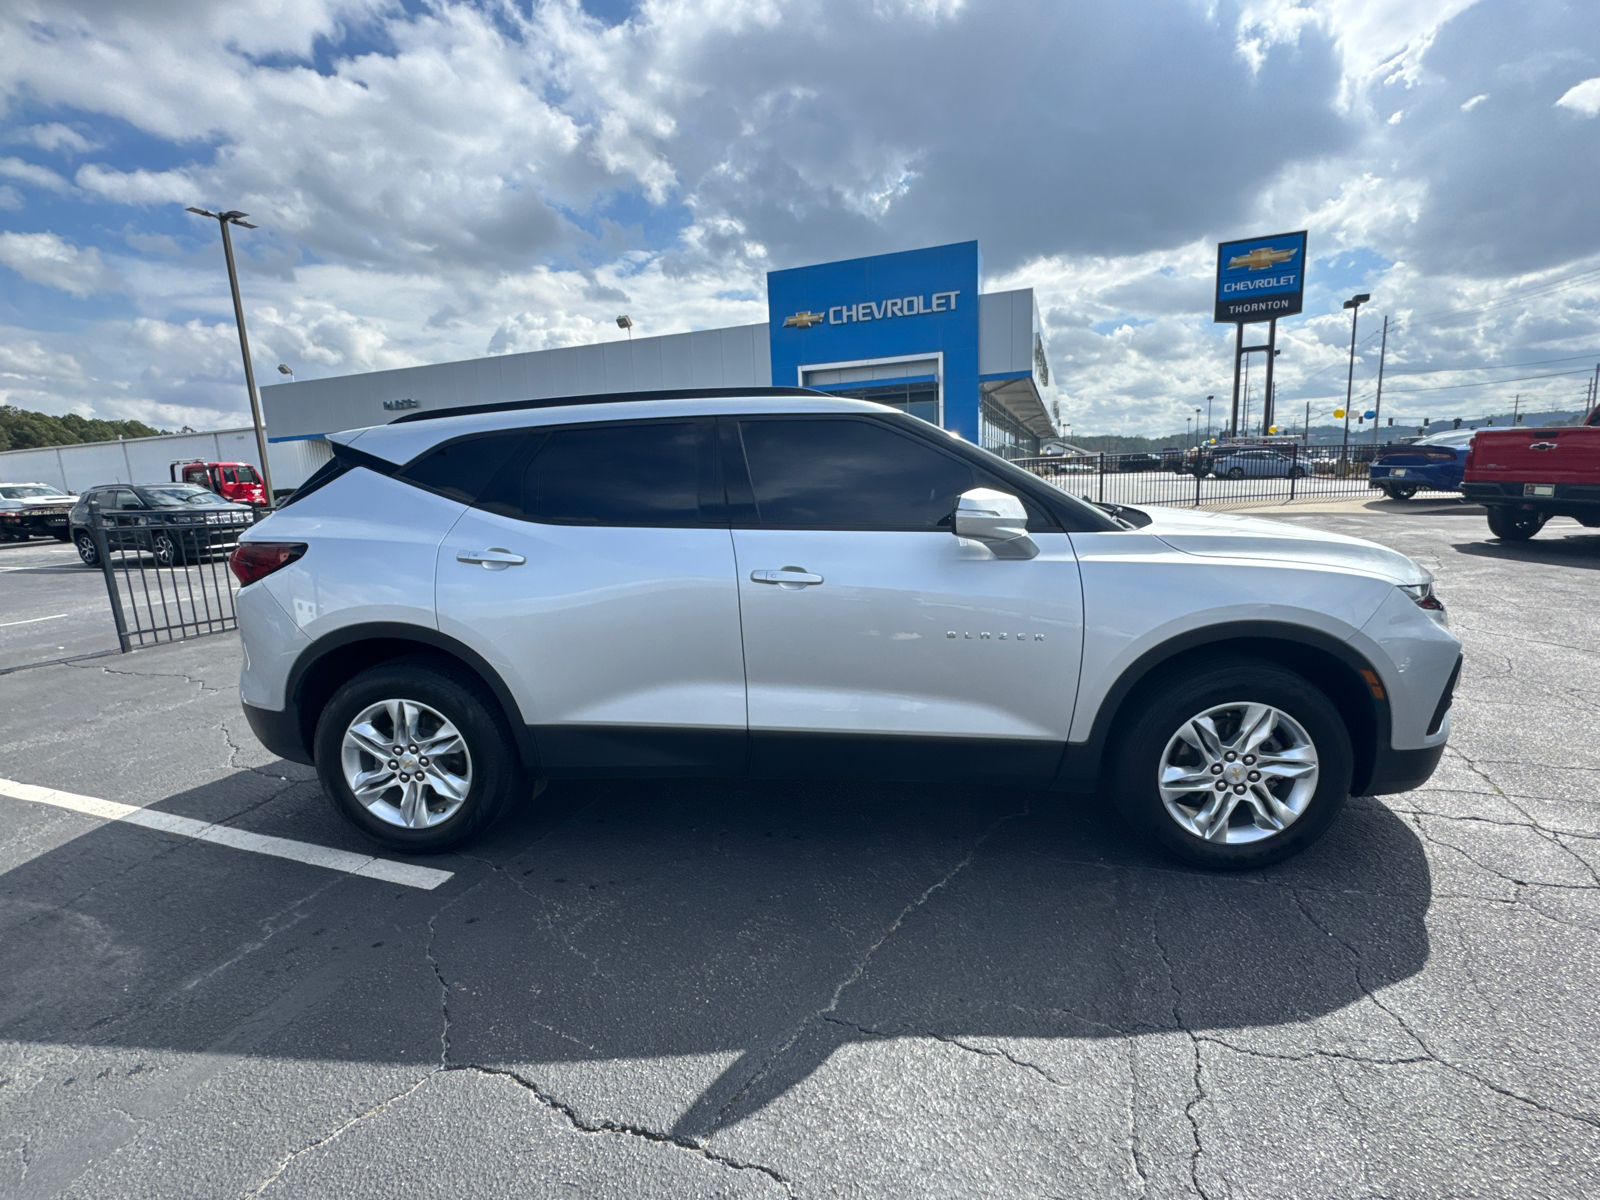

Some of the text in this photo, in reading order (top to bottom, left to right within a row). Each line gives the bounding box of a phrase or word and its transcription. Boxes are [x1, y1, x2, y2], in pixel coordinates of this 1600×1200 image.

[1223, 275, 1296, 293] CHEVROLET
[828, 290, 961, 325] CHEVROLET
[1229, 300, 1289, 314] THORNTON
[946, 630, 1045, 642] BLAZER
